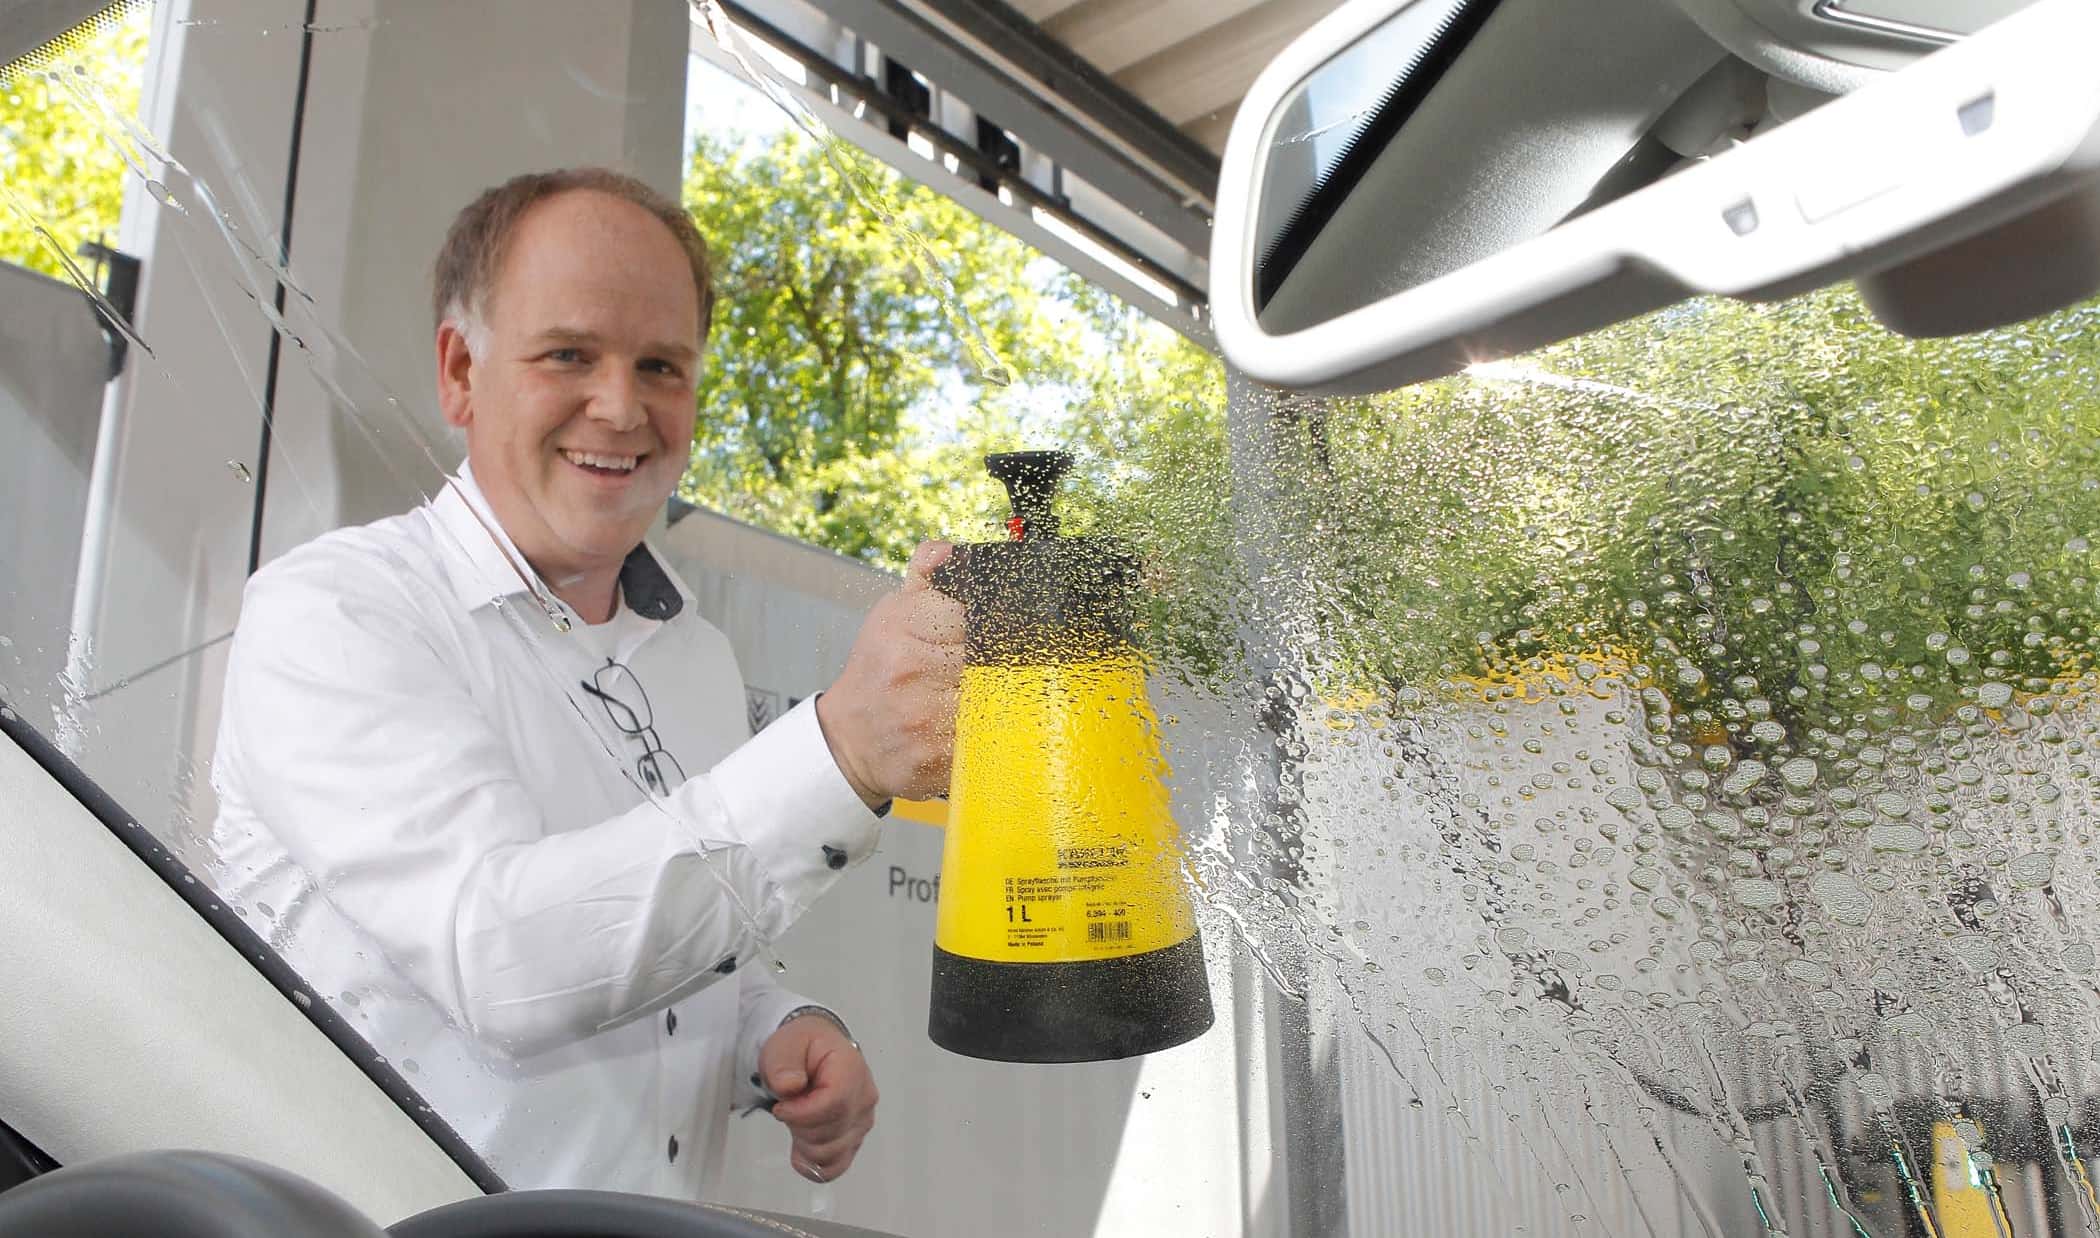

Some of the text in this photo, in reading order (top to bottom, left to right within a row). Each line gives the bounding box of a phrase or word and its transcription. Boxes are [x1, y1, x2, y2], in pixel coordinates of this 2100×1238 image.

[1017, 886, 1035, 895] Spray
[1018, 894, 1036, 903] Pump
[1037, 894, 1063, 903] sprayer
[1006, 904, 1032, 922] 1 L
